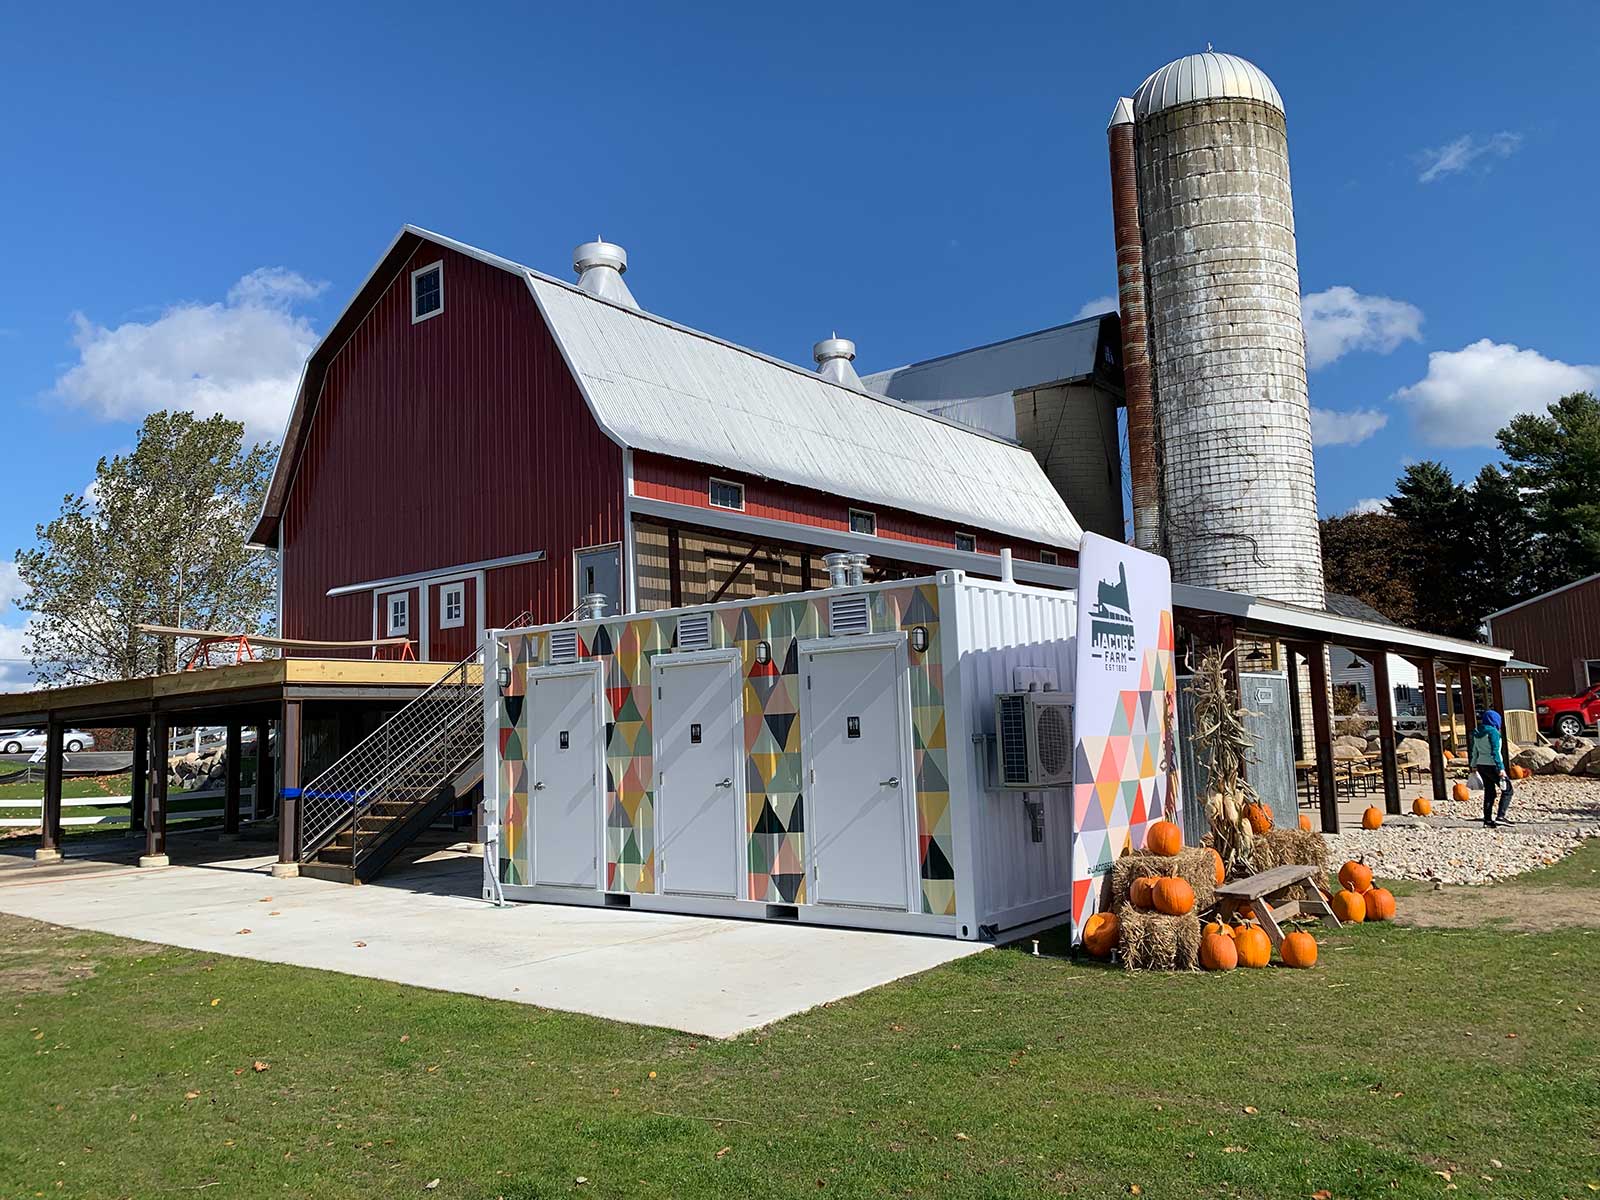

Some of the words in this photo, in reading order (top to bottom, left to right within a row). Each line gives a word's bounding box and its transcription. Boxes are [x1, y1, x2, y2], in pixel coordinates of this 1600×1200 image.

[1093, 632, 1136, 651] JACOB'S
[1105, 651, 1127, 664] FARM
[1105, 663, 1115, 671] EST
